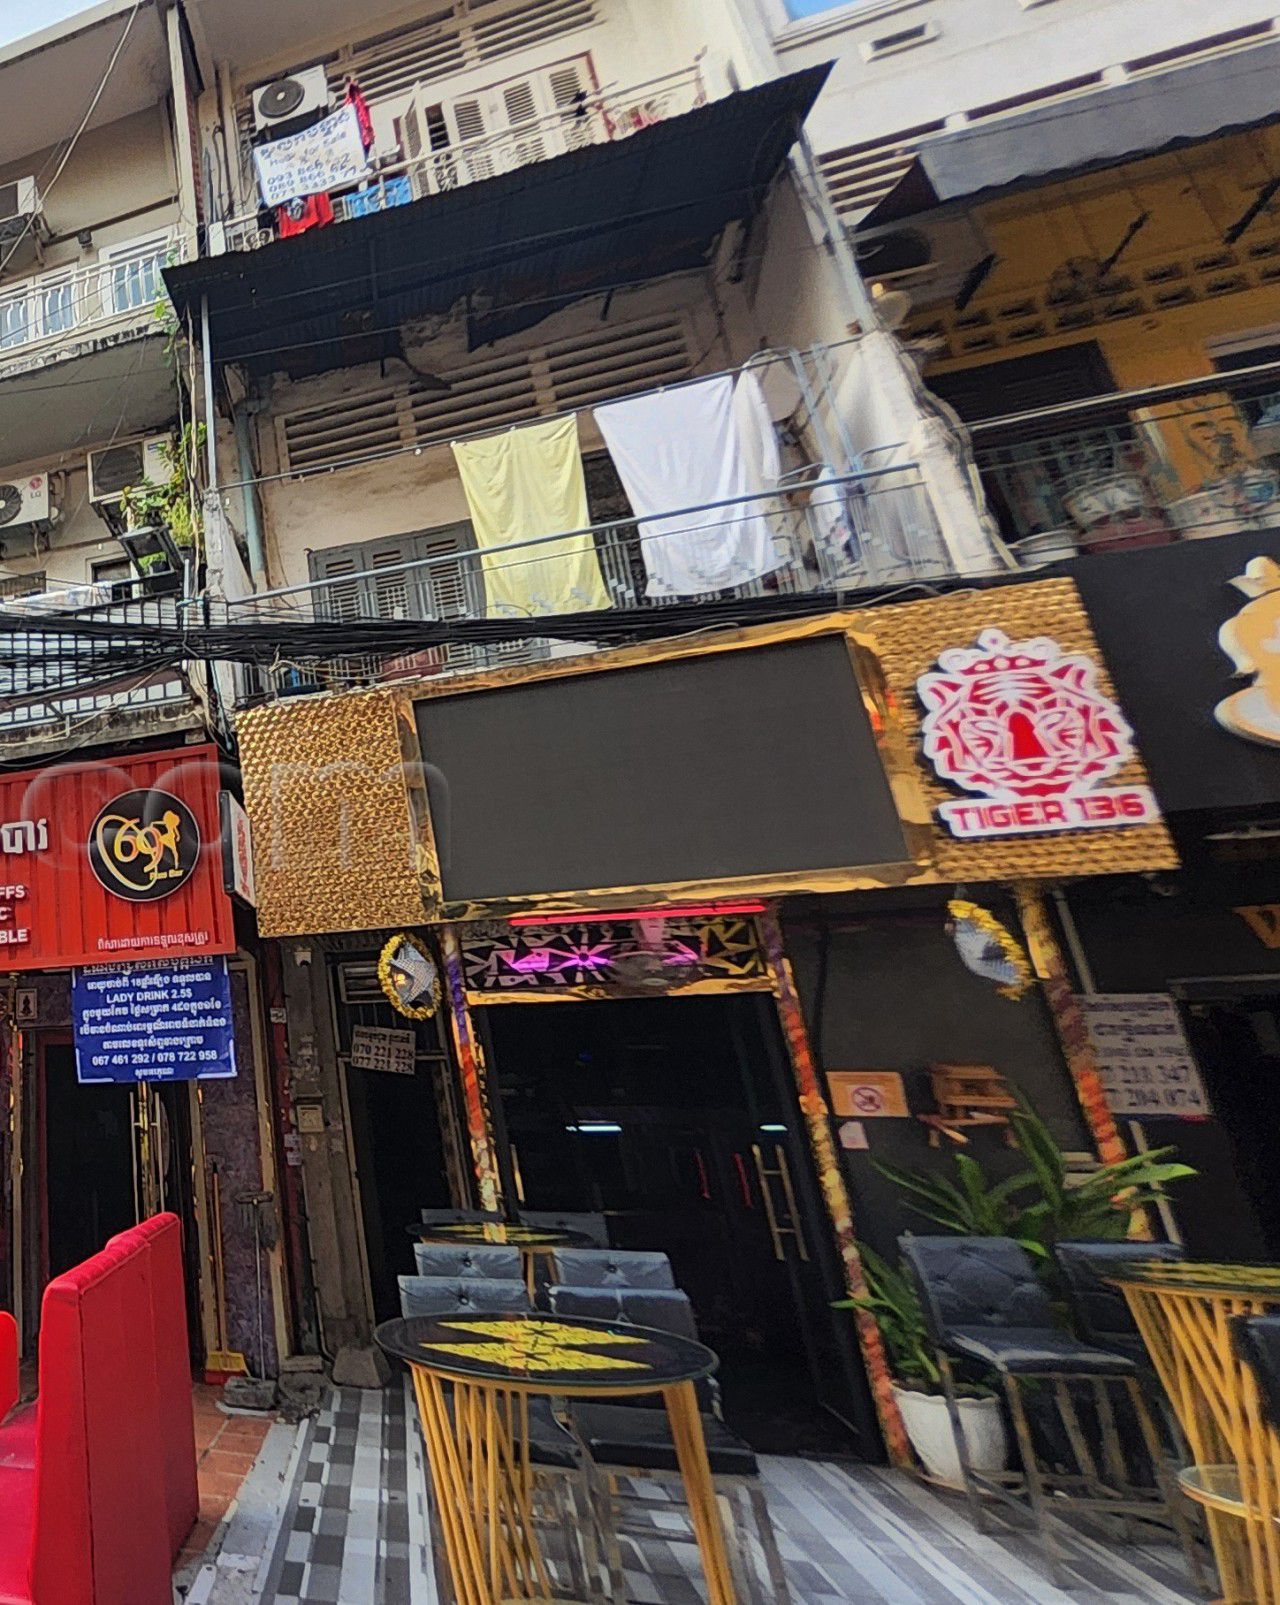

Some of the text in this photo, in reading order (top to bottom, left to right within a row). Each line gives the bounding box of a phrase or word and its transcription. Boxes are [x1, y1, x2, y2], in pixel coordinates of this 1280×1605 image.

[951, 793, 1146, 831] TIGER 136
[106, 988, 193, 1004] LADY DRINK 2.5$
[92, 1056, 111, 1066] 067
[111, 1054, 129, 1065] 461
[131, 1054, 150, 1064] 292
[156, 1052, 176, 1063] 078
[178, 1051, 197, 1062] 722
[198, 1050, 218, 1061] 958
[354, 1043, 372, 1056] 070
[373, 1045, 392, 1059] 221
